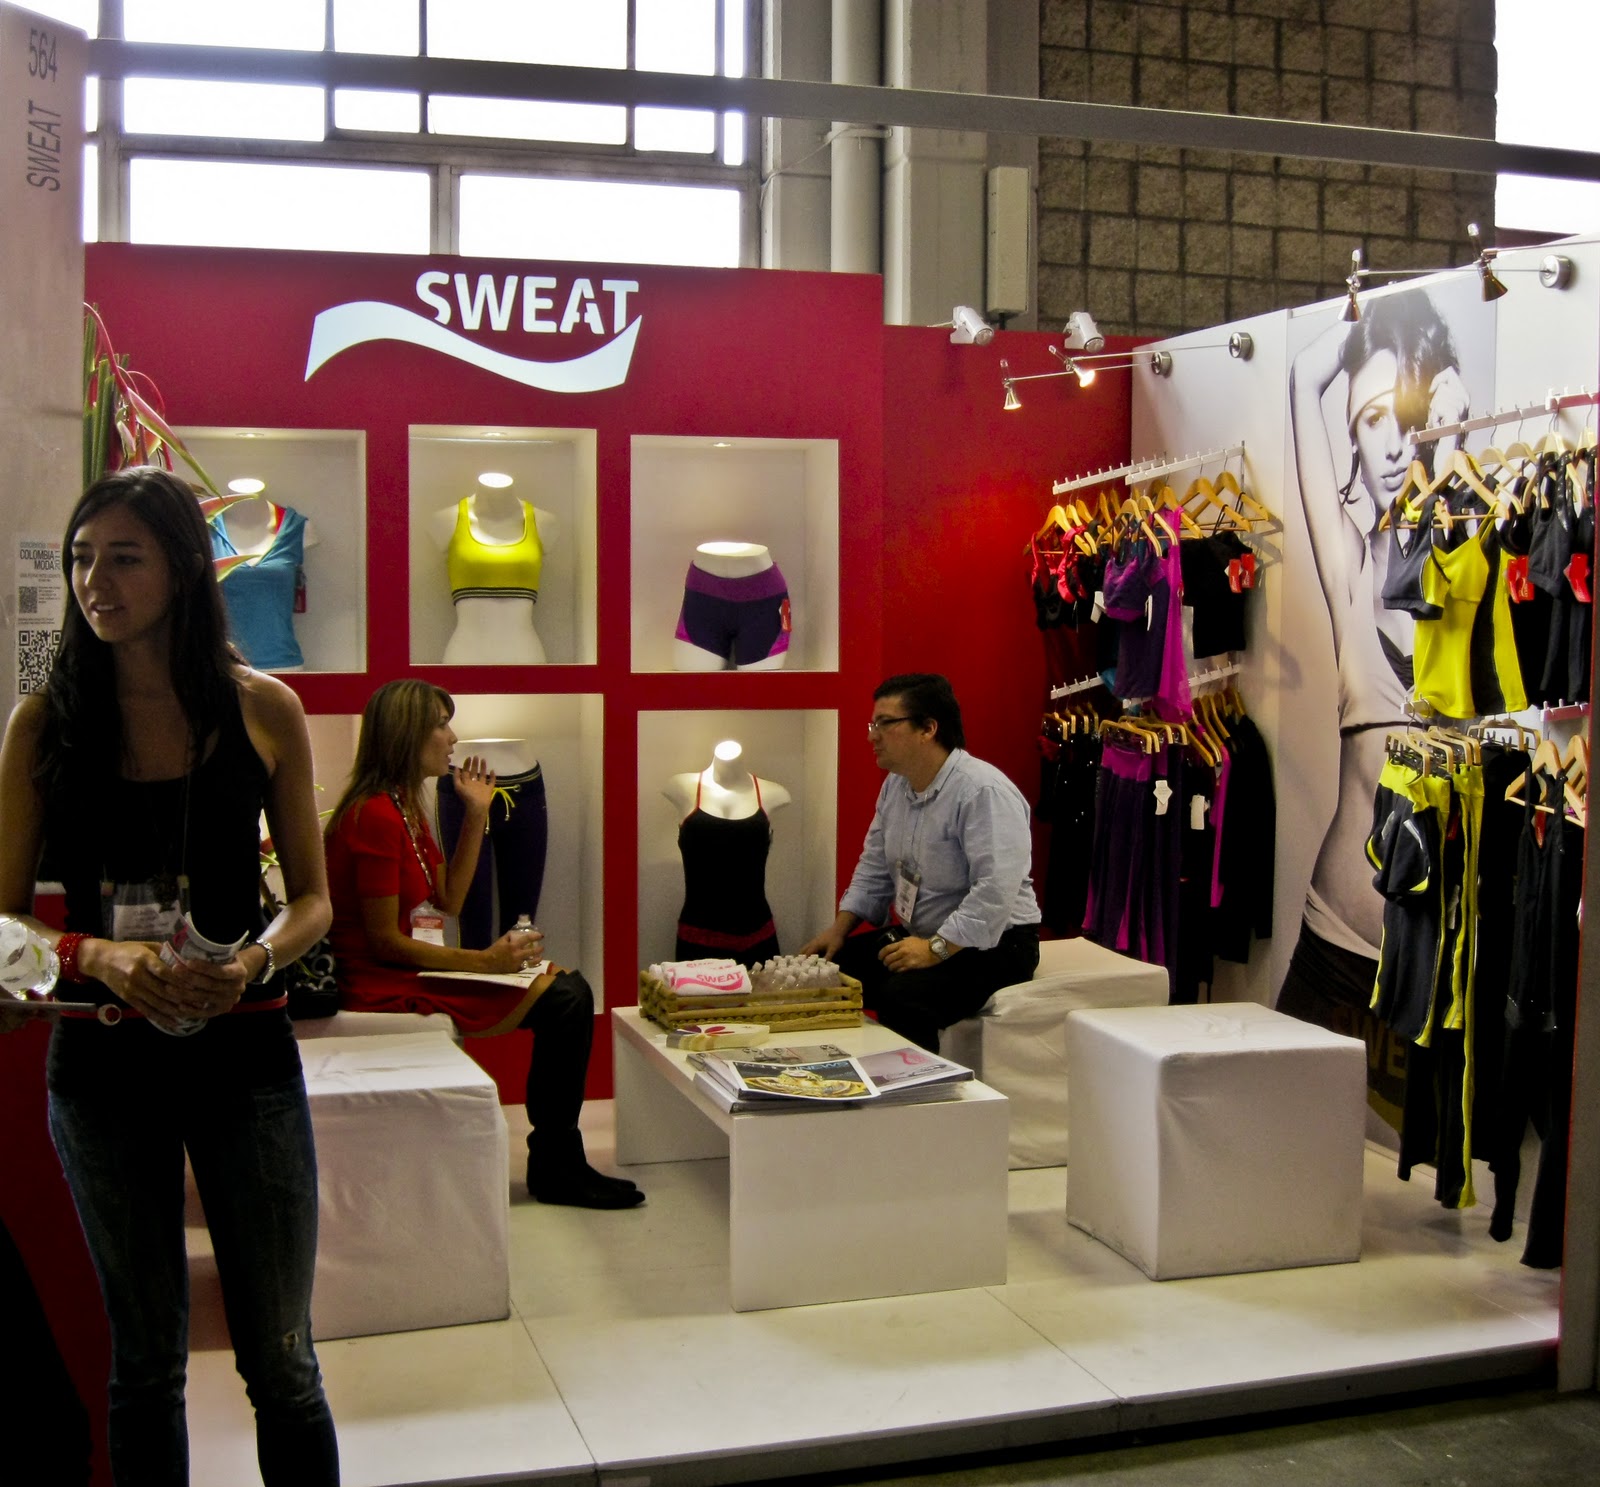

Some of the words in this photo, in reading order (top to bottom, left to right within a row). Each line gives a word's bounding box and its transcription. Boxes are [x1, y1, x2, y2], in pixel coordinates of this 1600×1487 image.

[28, 29, 58, 82] 564
[27, 99, 61, 192] SWEAT
[416, 271, 639, 334] SWEAT
[20, 549, 55, 560] COLOMBIA
[34, 560, 55, 571] MODA
[696, 971, 742, 983] SWEAT
